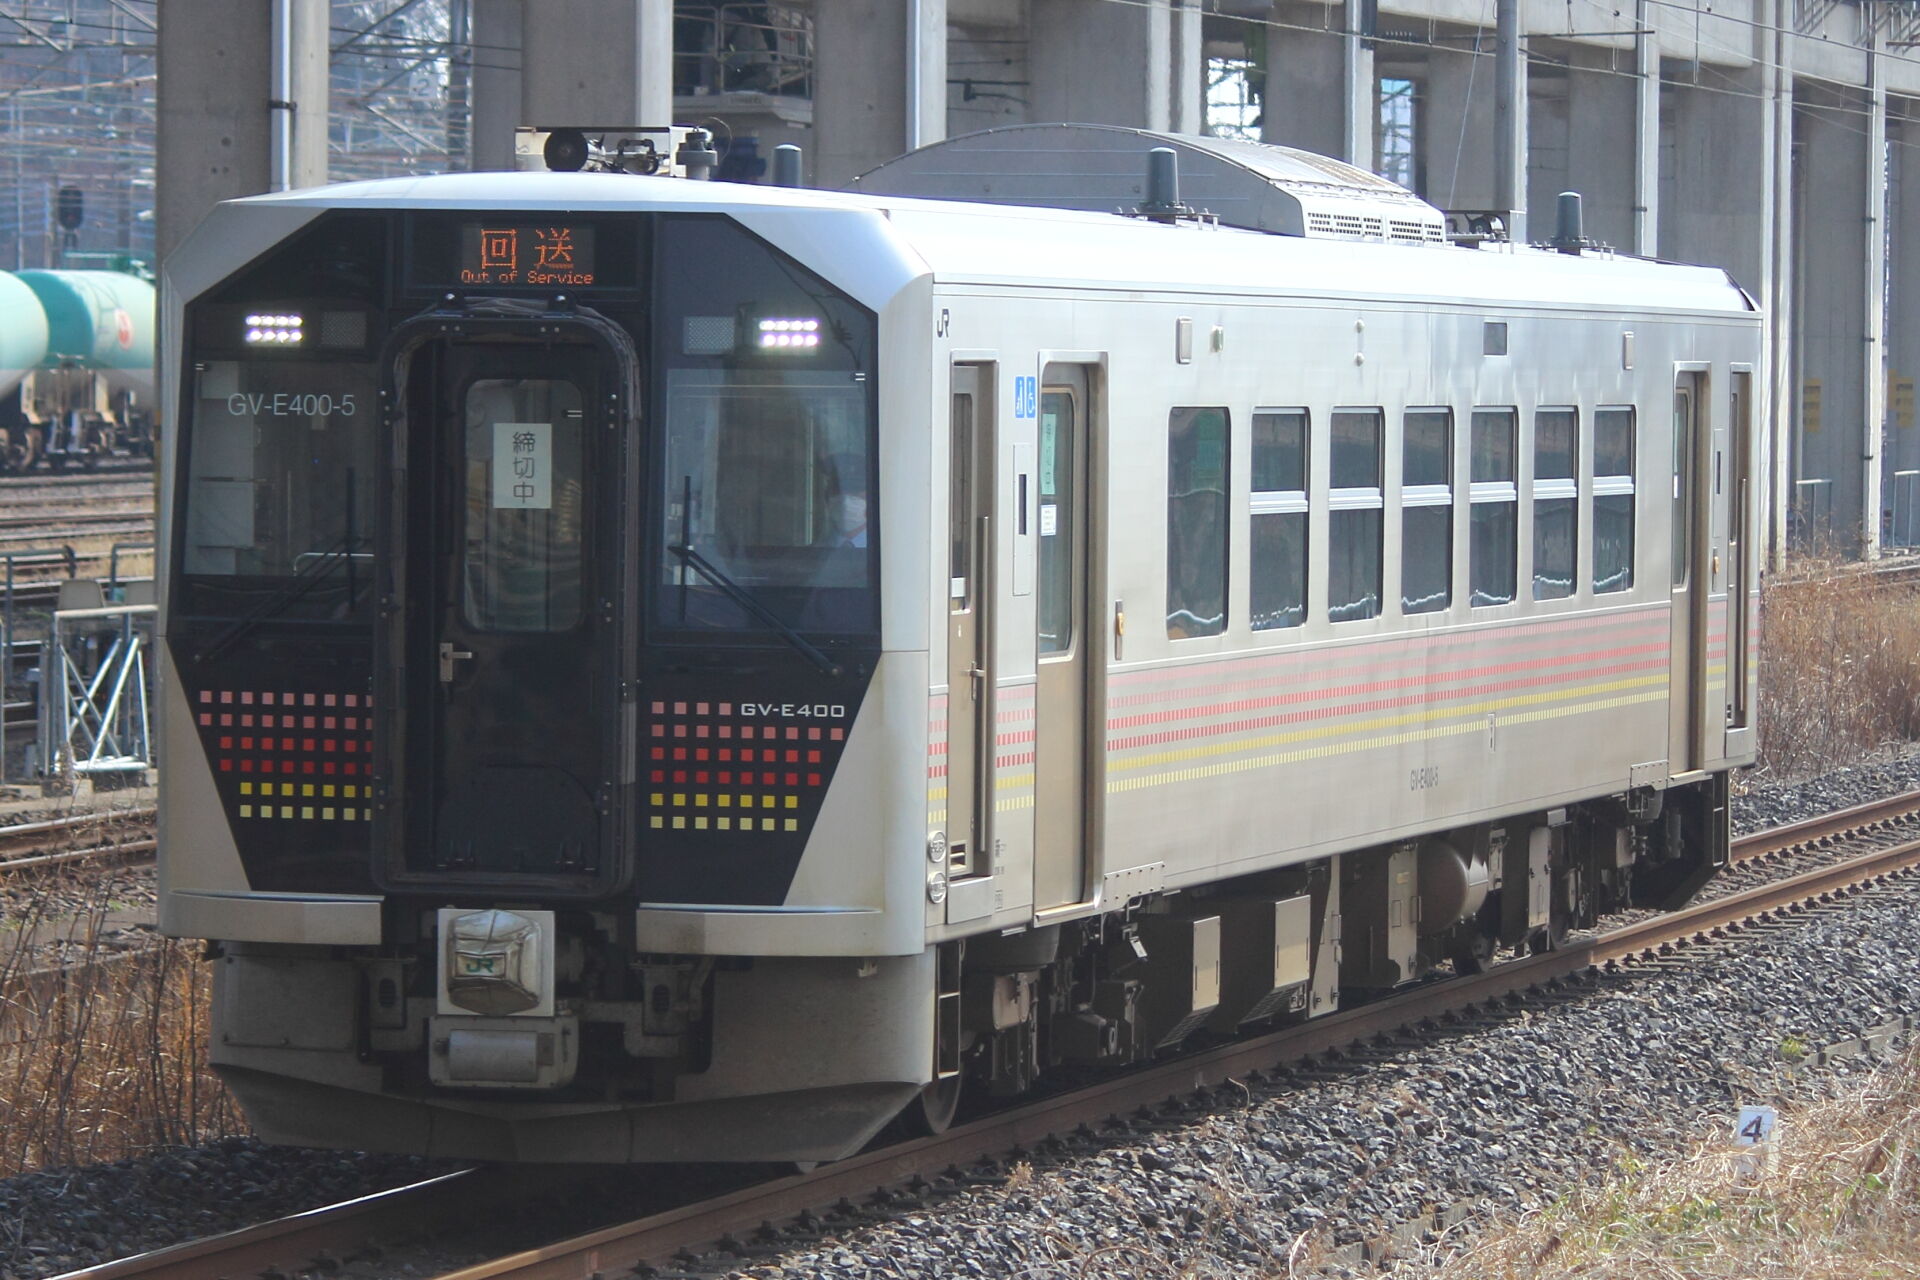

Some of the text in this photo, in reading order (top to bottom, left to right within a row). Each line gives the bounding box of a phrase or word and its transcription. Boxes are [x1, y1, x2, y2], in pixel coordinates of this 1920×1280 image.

[481, 228, 574, 270] 回送
[461, 269, 593, 285] Out of Service
[936, 308, 950, 338] JR
[228, 393, 356, 416] GV-E400-5
[512, 431, 536, 504] 締切中
[741, 703, 845, 718] GV-E400
[466, 957, 494, 974] JR
[1741, 1115, 1763, 1143] 4
